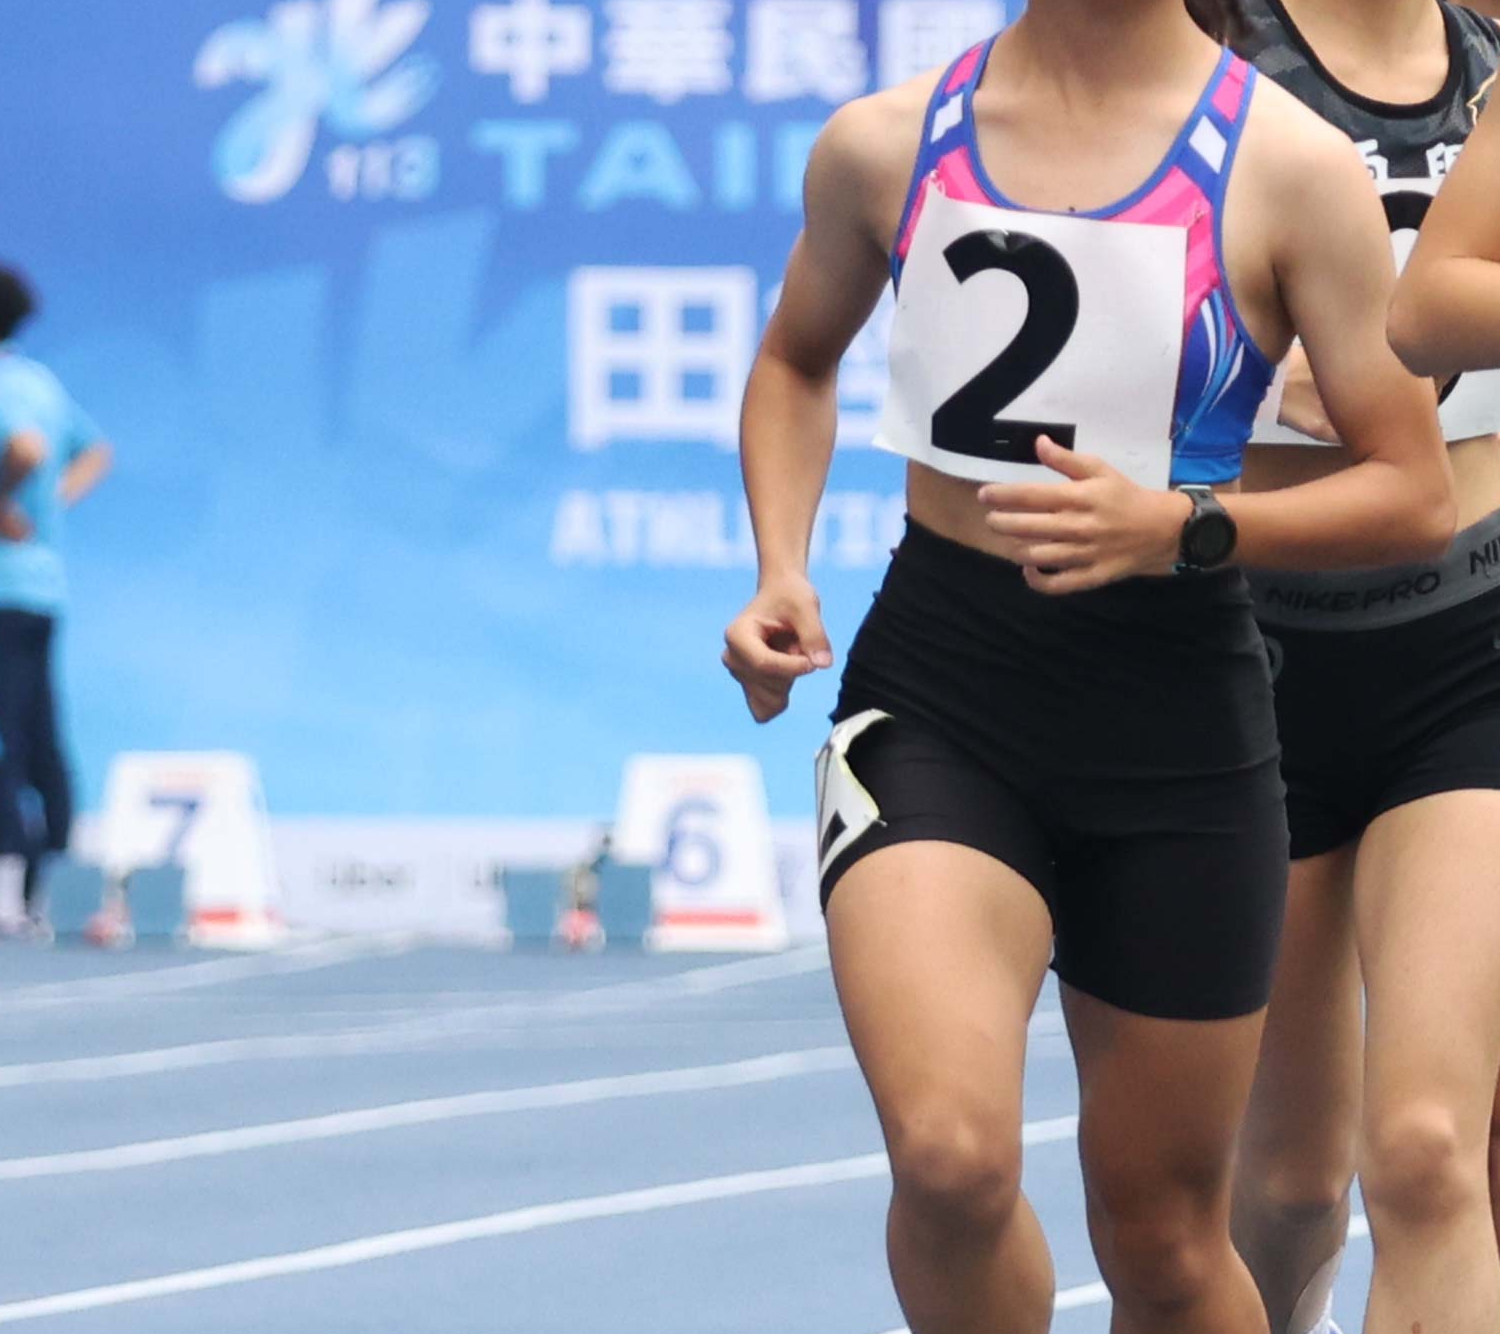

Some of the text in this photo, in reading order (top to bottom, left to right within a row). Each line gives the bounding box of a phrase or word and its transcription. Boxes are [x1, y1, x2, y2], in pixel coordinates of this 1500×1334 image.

[931, 228, 1080, 465] 2
[1265, 571, 1441, 612] NIKE PRO
[146, 791, 204, 867] 7
[665, 793, 723, 888] 6
